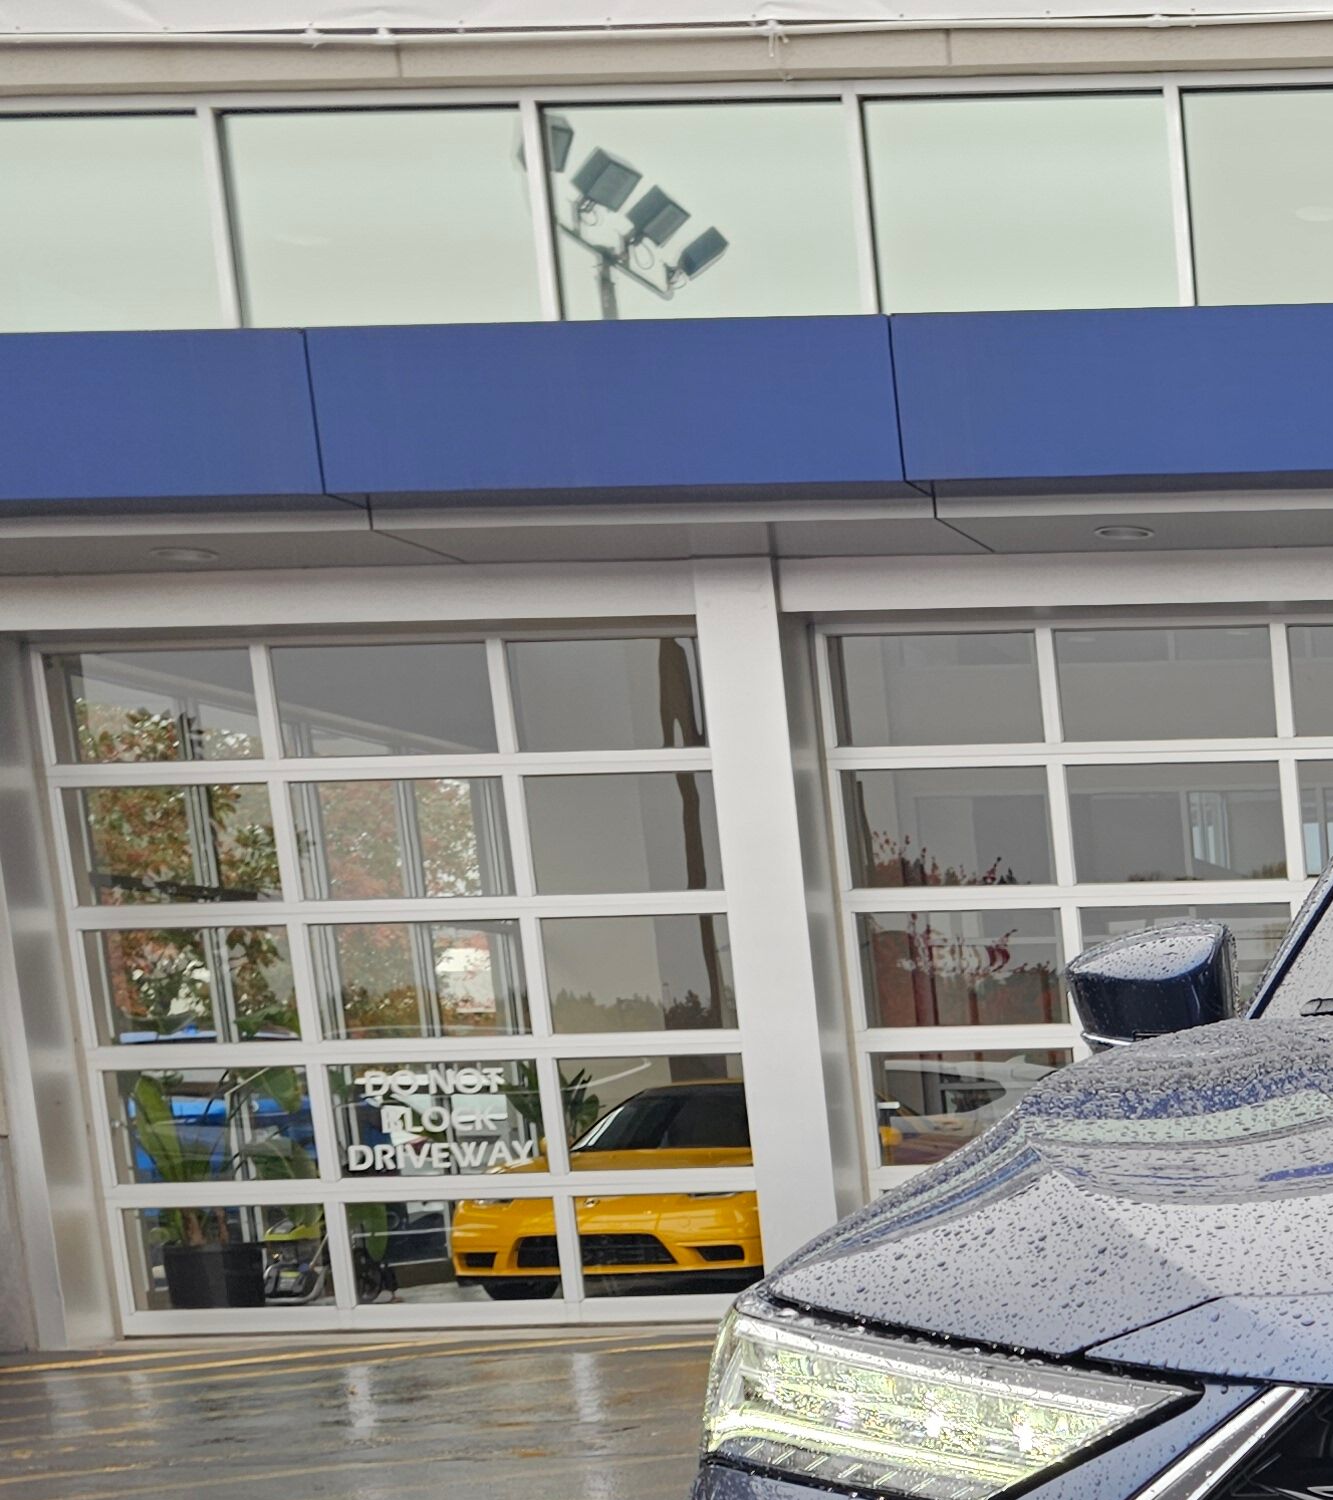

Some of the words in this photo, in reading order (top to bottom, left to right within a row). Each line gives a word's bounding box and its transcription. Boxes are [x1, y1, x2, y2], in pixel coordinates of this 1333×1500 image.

[365, 1070, 419, 1096] DO
[429, 1067, 504, 1095] NOT
[381, 1105, 498, 1134] BLOCK
[348, 1140, 535, 1172] DRIVEWAY
